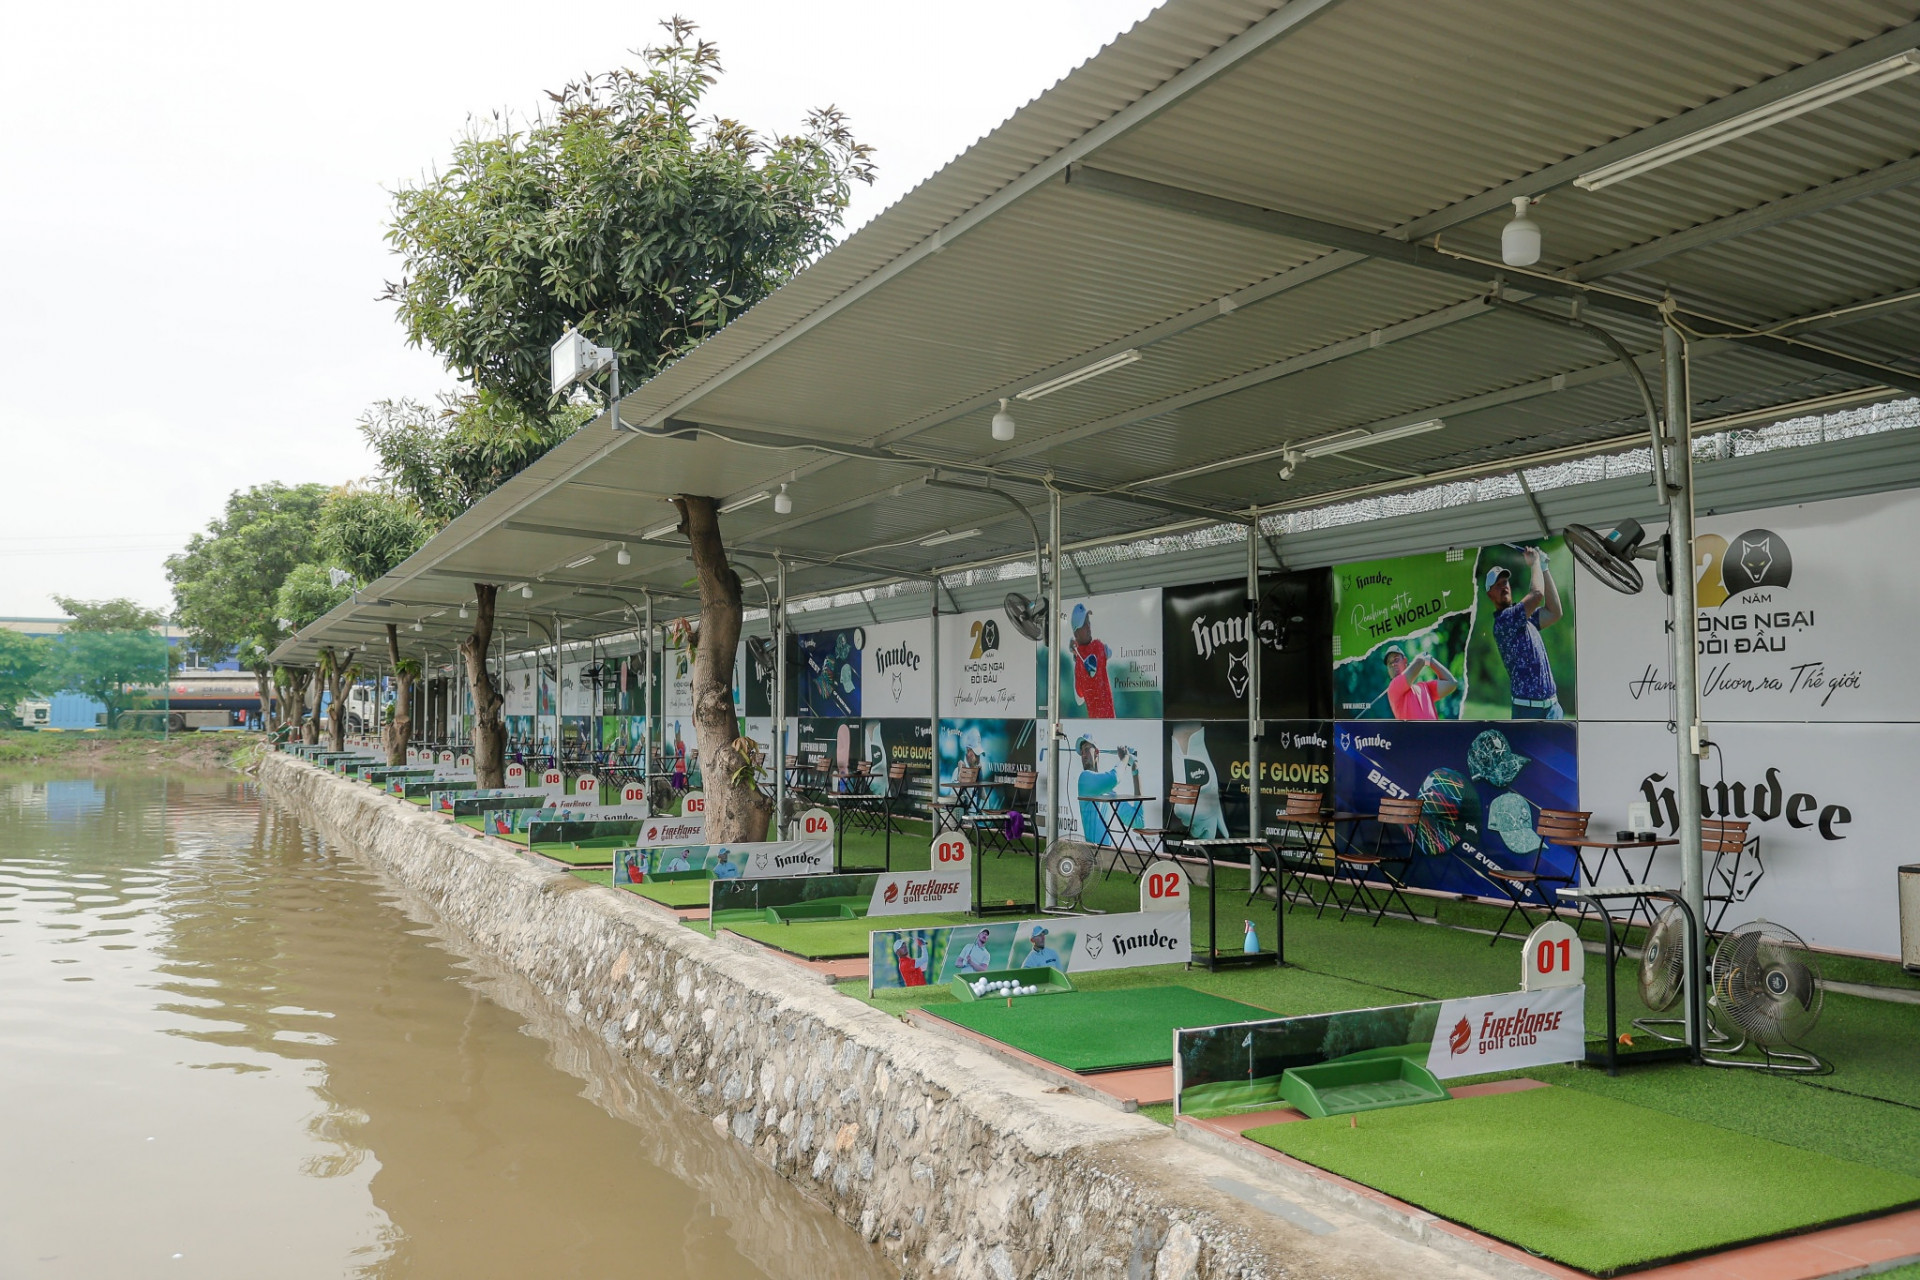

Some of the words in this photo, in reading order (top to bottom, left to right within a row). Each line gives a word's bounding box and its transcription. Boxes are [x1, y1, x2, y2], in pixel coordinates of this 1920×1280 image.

[1742, 593, 1772, 605] NĂM
[1368, 618, 1393, 638] THE
[1394, 598, 1442, 628] WORLD
[1664, 611, 1748, 634] KÔNG
[1754, 610, 1815, 632] NGẠI
[1120, 645, 1157, 658] Luxurious
[1129, 661, 1156, 676] Elegant
[1114, 676, 1158, 689] Professional
[892, 745, 909, 759] GOLF
[910, 746, 932, 760] GLOVE
[461, 758, 469, 766] 11
[509, 767, 522, 777] 09
[545, 774, 560, 784] 08
[1230, 760, 1267, 780] GOF
[1270, 762, 1330, 785] GLOVES
[579, 779, 595, 791] 07
[1366, 768, 1410, 800] BEST
[625, 788, 643, 801] 06
[687, 798, 705, 813] 05
[805, 817, 828, 834] 04
[939, 842, 965, 862] 03
[1461, 841, 1476, 856] OF
[1149, 872, 1180, 899] 02
[903, 893, 920, 905] golf
[923, 893, 943, 902] club
[1536, 938, 1571, 974] 01
[1479, 1033, 1505, 1055] golf
[1508, 1030, 1537, 1047] club
